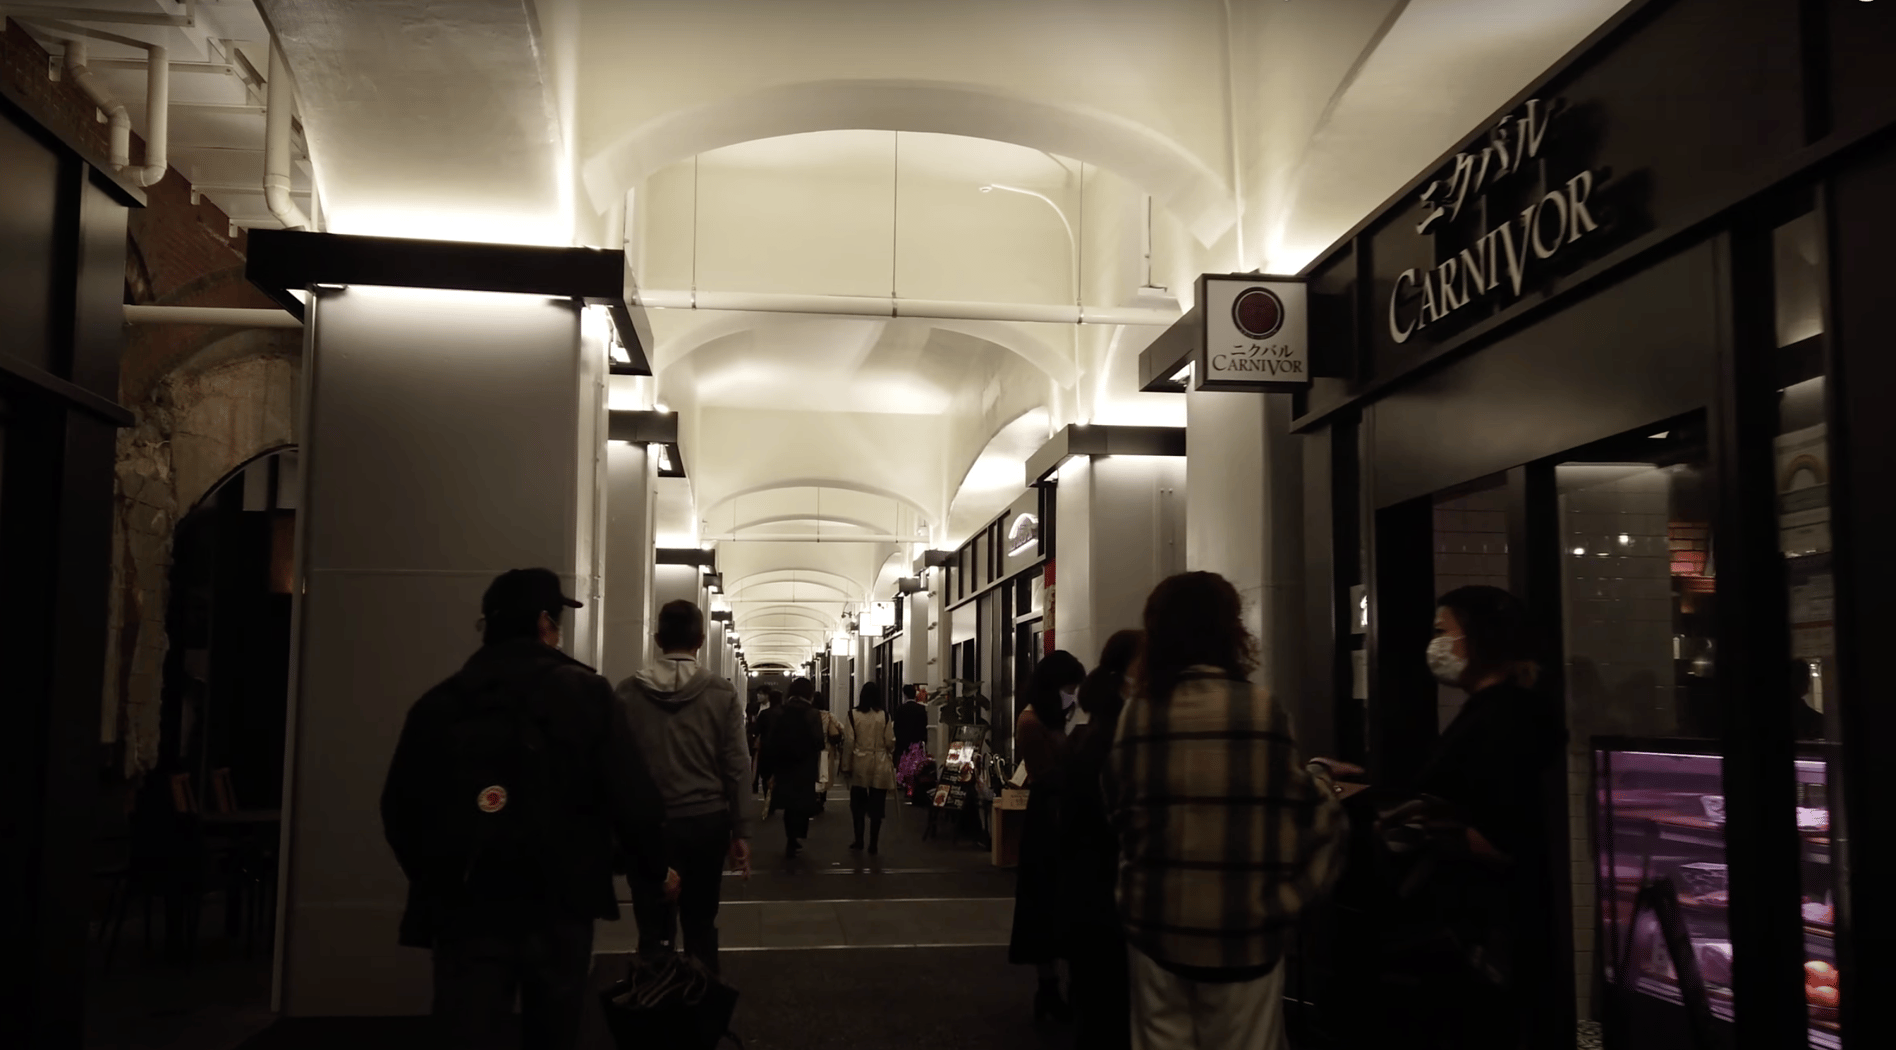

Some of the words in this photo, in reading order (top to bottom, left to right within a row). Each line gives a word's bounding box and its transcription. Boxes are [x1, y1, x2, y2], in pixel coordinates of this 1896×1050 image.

[1416, 99, 1549, 235] ニクバル
[1389, 170, 1598, 343] CARNIVOR
[1212, 354, 1303, 376] CARNIVOR
[1231, 344, 1294, 358] ニクバル
